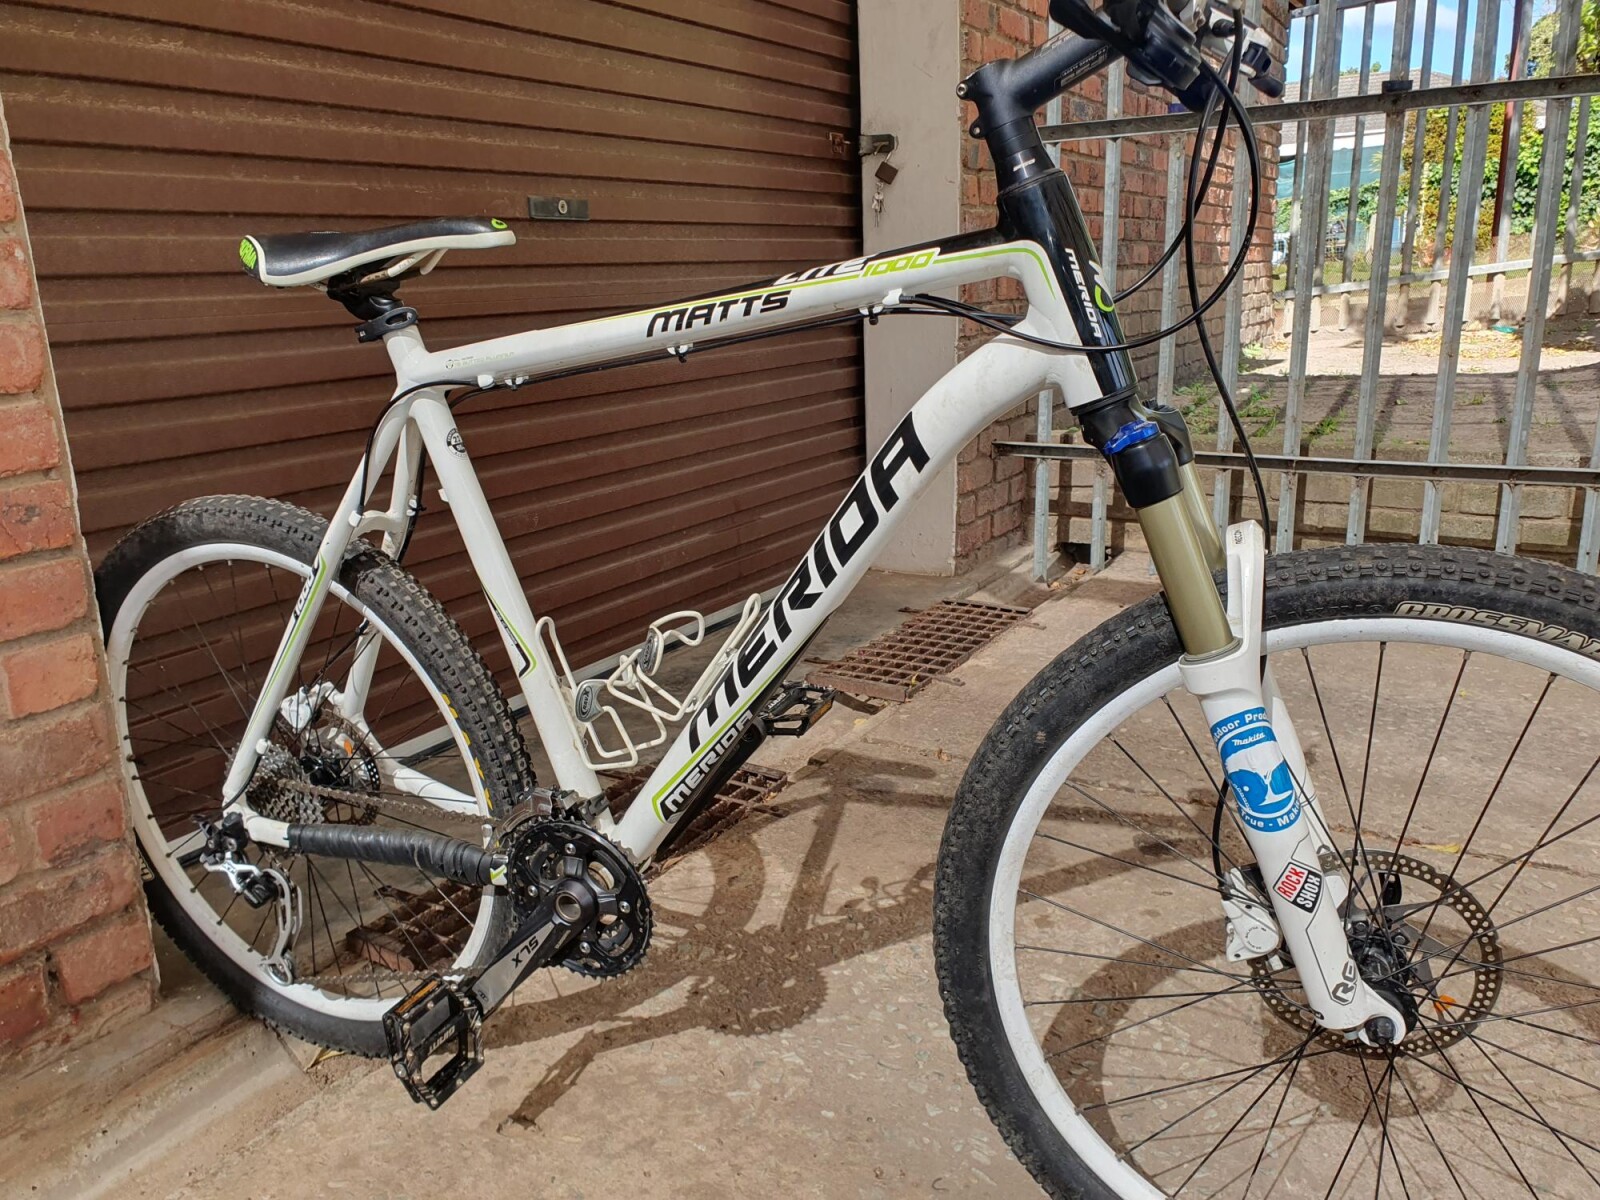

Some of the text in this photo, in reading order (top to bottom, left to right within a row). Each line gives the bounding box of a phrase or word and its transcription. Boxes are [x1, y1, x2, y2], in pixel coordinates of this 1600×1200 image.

[860, 250, 938, 278] 1000
[646, 289, 791, 338] MATTS
[1065, 247, 1102, 338] MERIDA
[689, 410, 931, 755] MERIDA
[1393, 601, 1600, 657] CROSSMA
[663, 709, 753, 813] MERIDA
[1277, 866, 1306, 899] ROCK
[1296, 874, 1321, 908] SHOX
[511, 935, 540, 968] SLX
